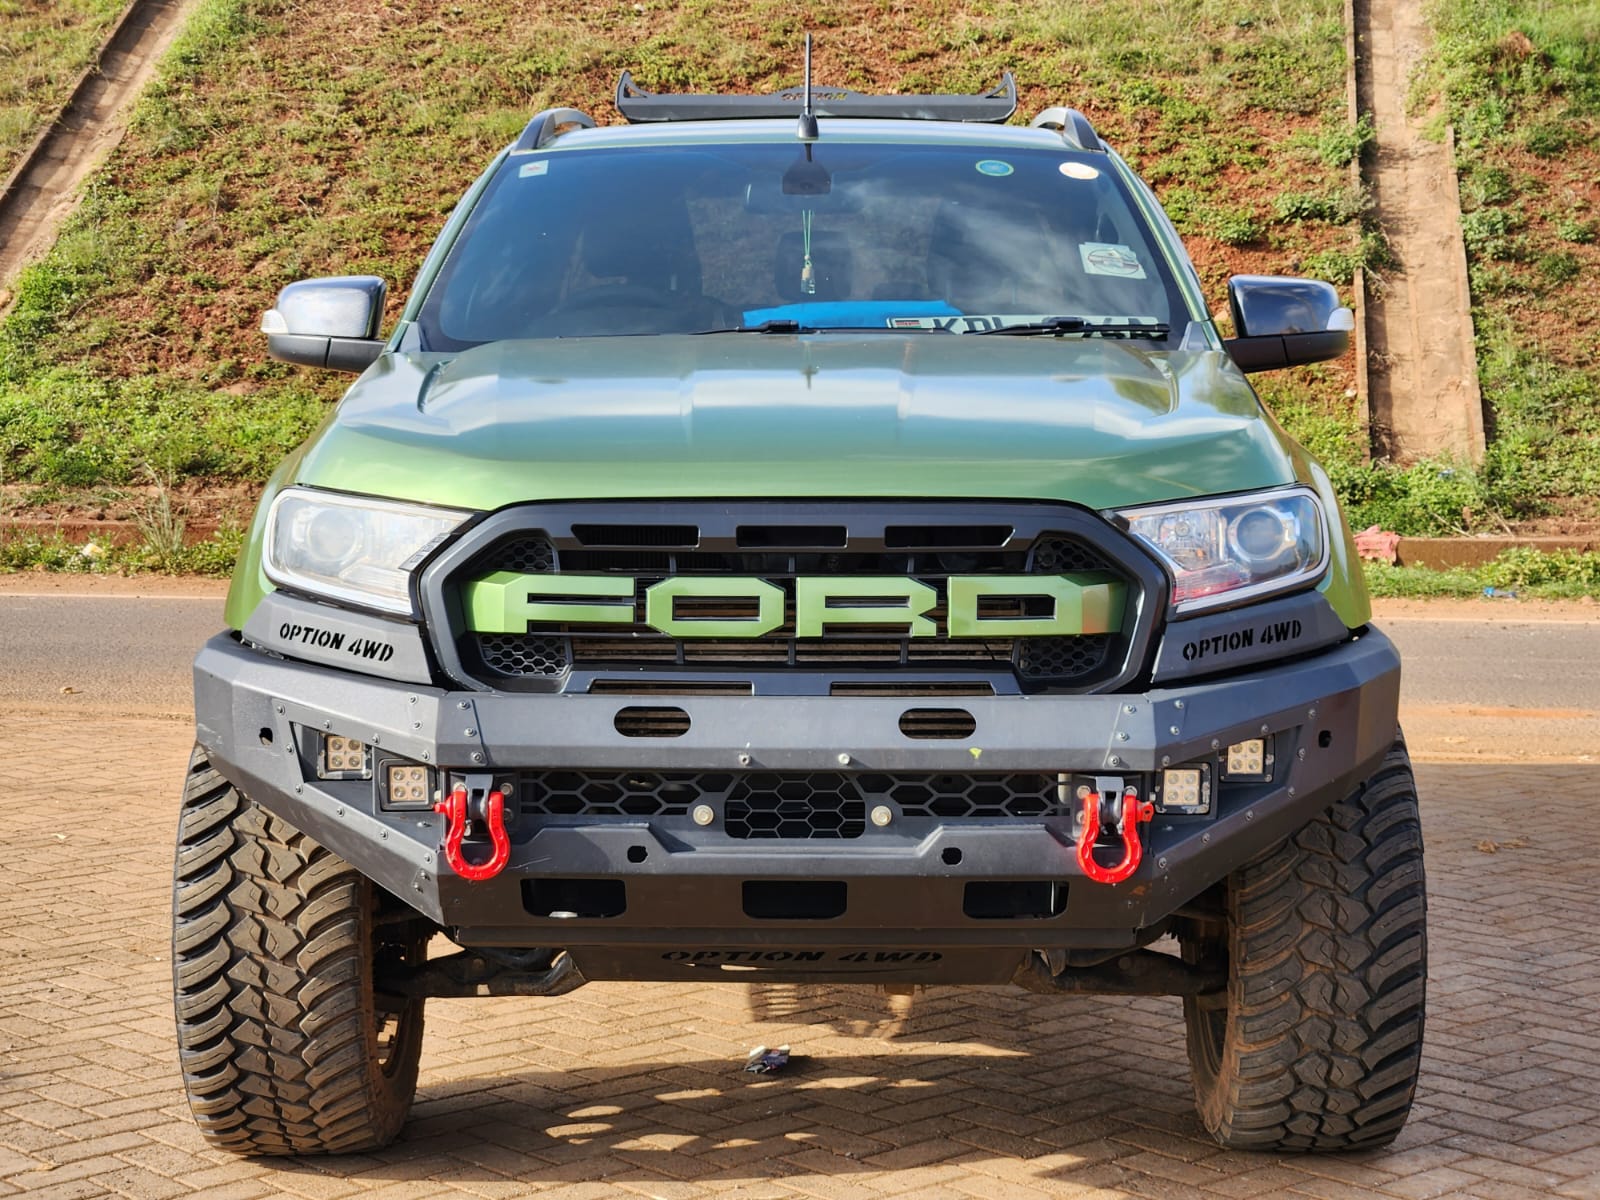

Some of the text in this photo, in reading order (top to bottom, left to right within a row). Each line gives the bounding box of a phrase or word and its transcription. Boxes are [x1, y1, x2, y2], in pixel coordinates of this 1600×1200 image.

[469, 570, 1124, 638] FORD
[280, 622, 394, 662] OPTION 4WD
[1182, 619, 1302, 661] OPTION 4WD
[661, 950, 943, 963] OPTION 4WD
